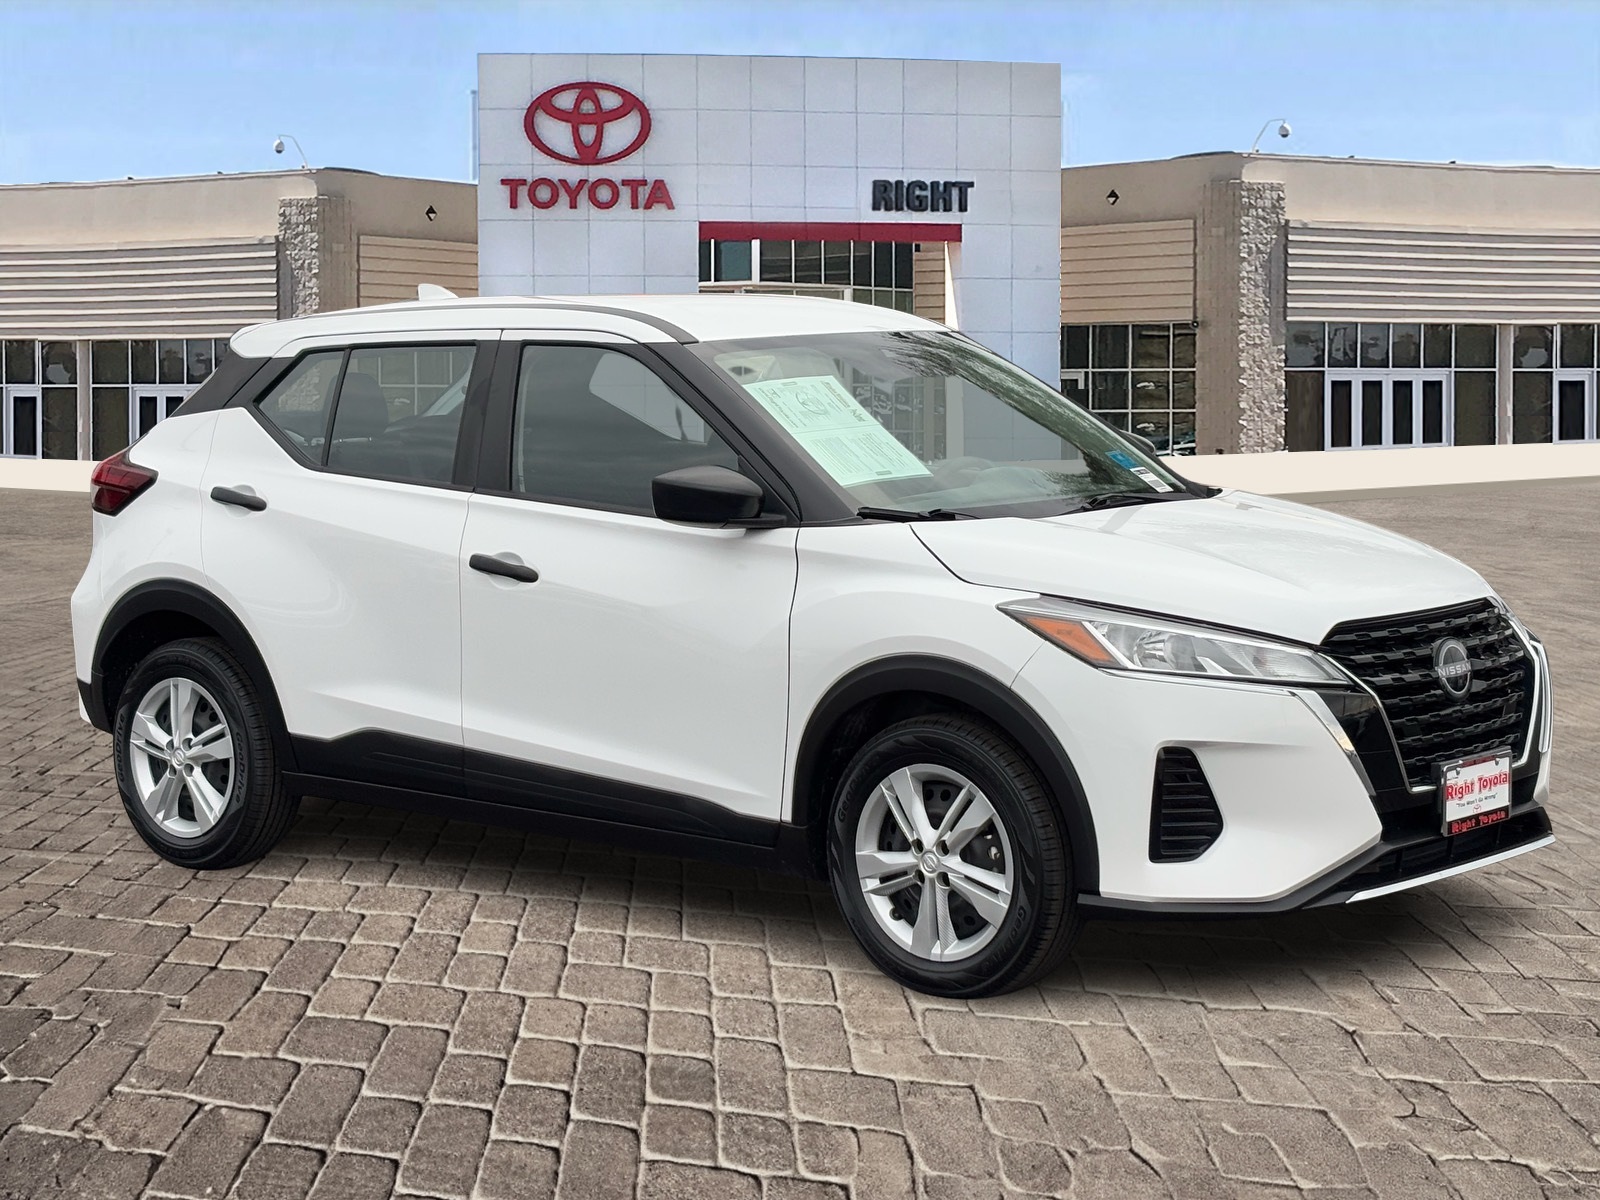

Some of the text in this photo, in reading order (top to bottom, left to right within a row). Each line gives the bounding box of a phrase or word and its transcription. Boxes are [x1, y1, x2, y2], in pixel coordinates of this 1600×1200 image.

[501, 178, 675, 210] TOYOTA
[871, 179, 975, 213] RIGHT
[1437, 662, 1472, 676] NISSAN
[1446, 772, 1508, 800] Right Toyota
[1451, 810, 1506, 833] Right Toyota
